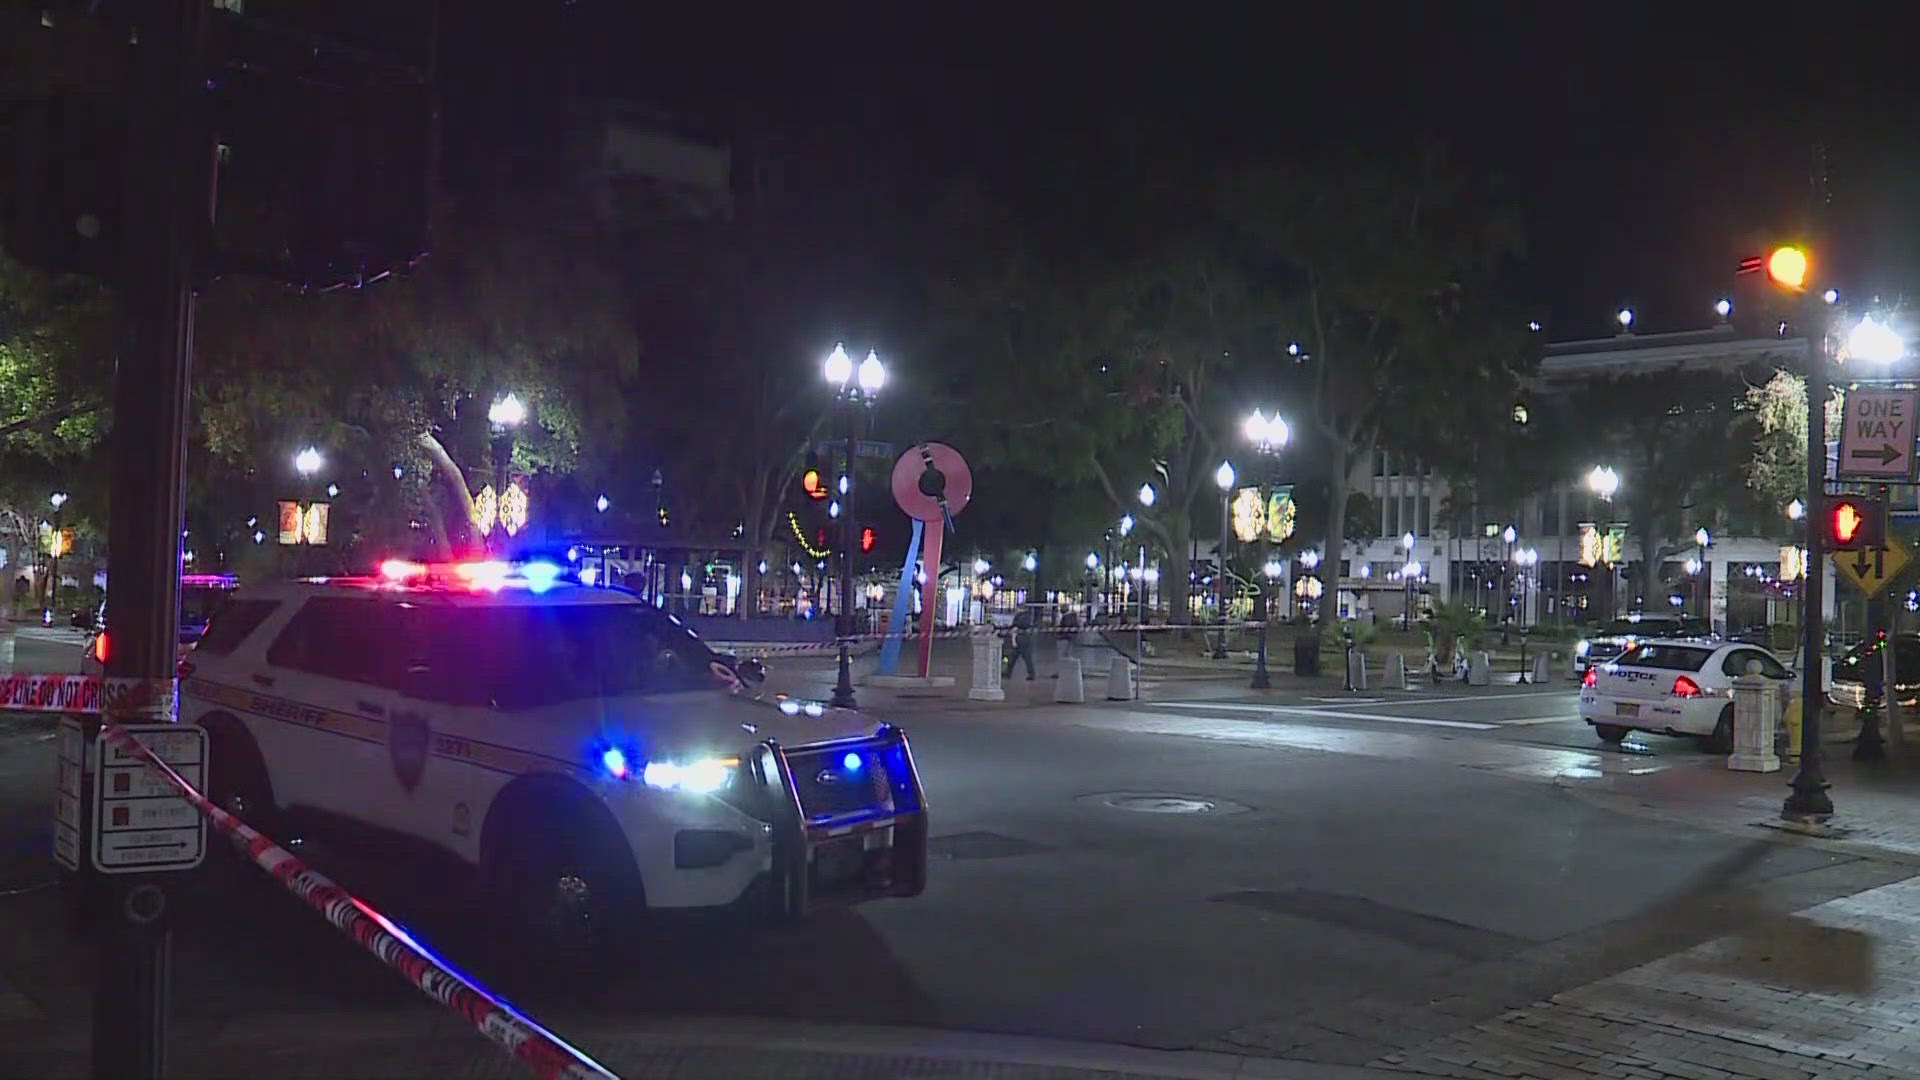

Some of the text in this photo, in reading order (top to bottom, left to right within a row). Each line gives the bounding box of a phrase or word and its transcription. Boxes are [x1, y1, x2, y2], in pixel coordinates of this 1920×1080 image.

[1858, 399, 1903, 416] ONE
[1858, 420, 1904, 438] WAY
[1609, 670, 1657, 680] POLICE
[13, 679, 37, 705] LINE
[38, 680, 54, 706] DO
[57, 680, 80, 707] NOT
[250, 696, 326, 726] SHERIFF
